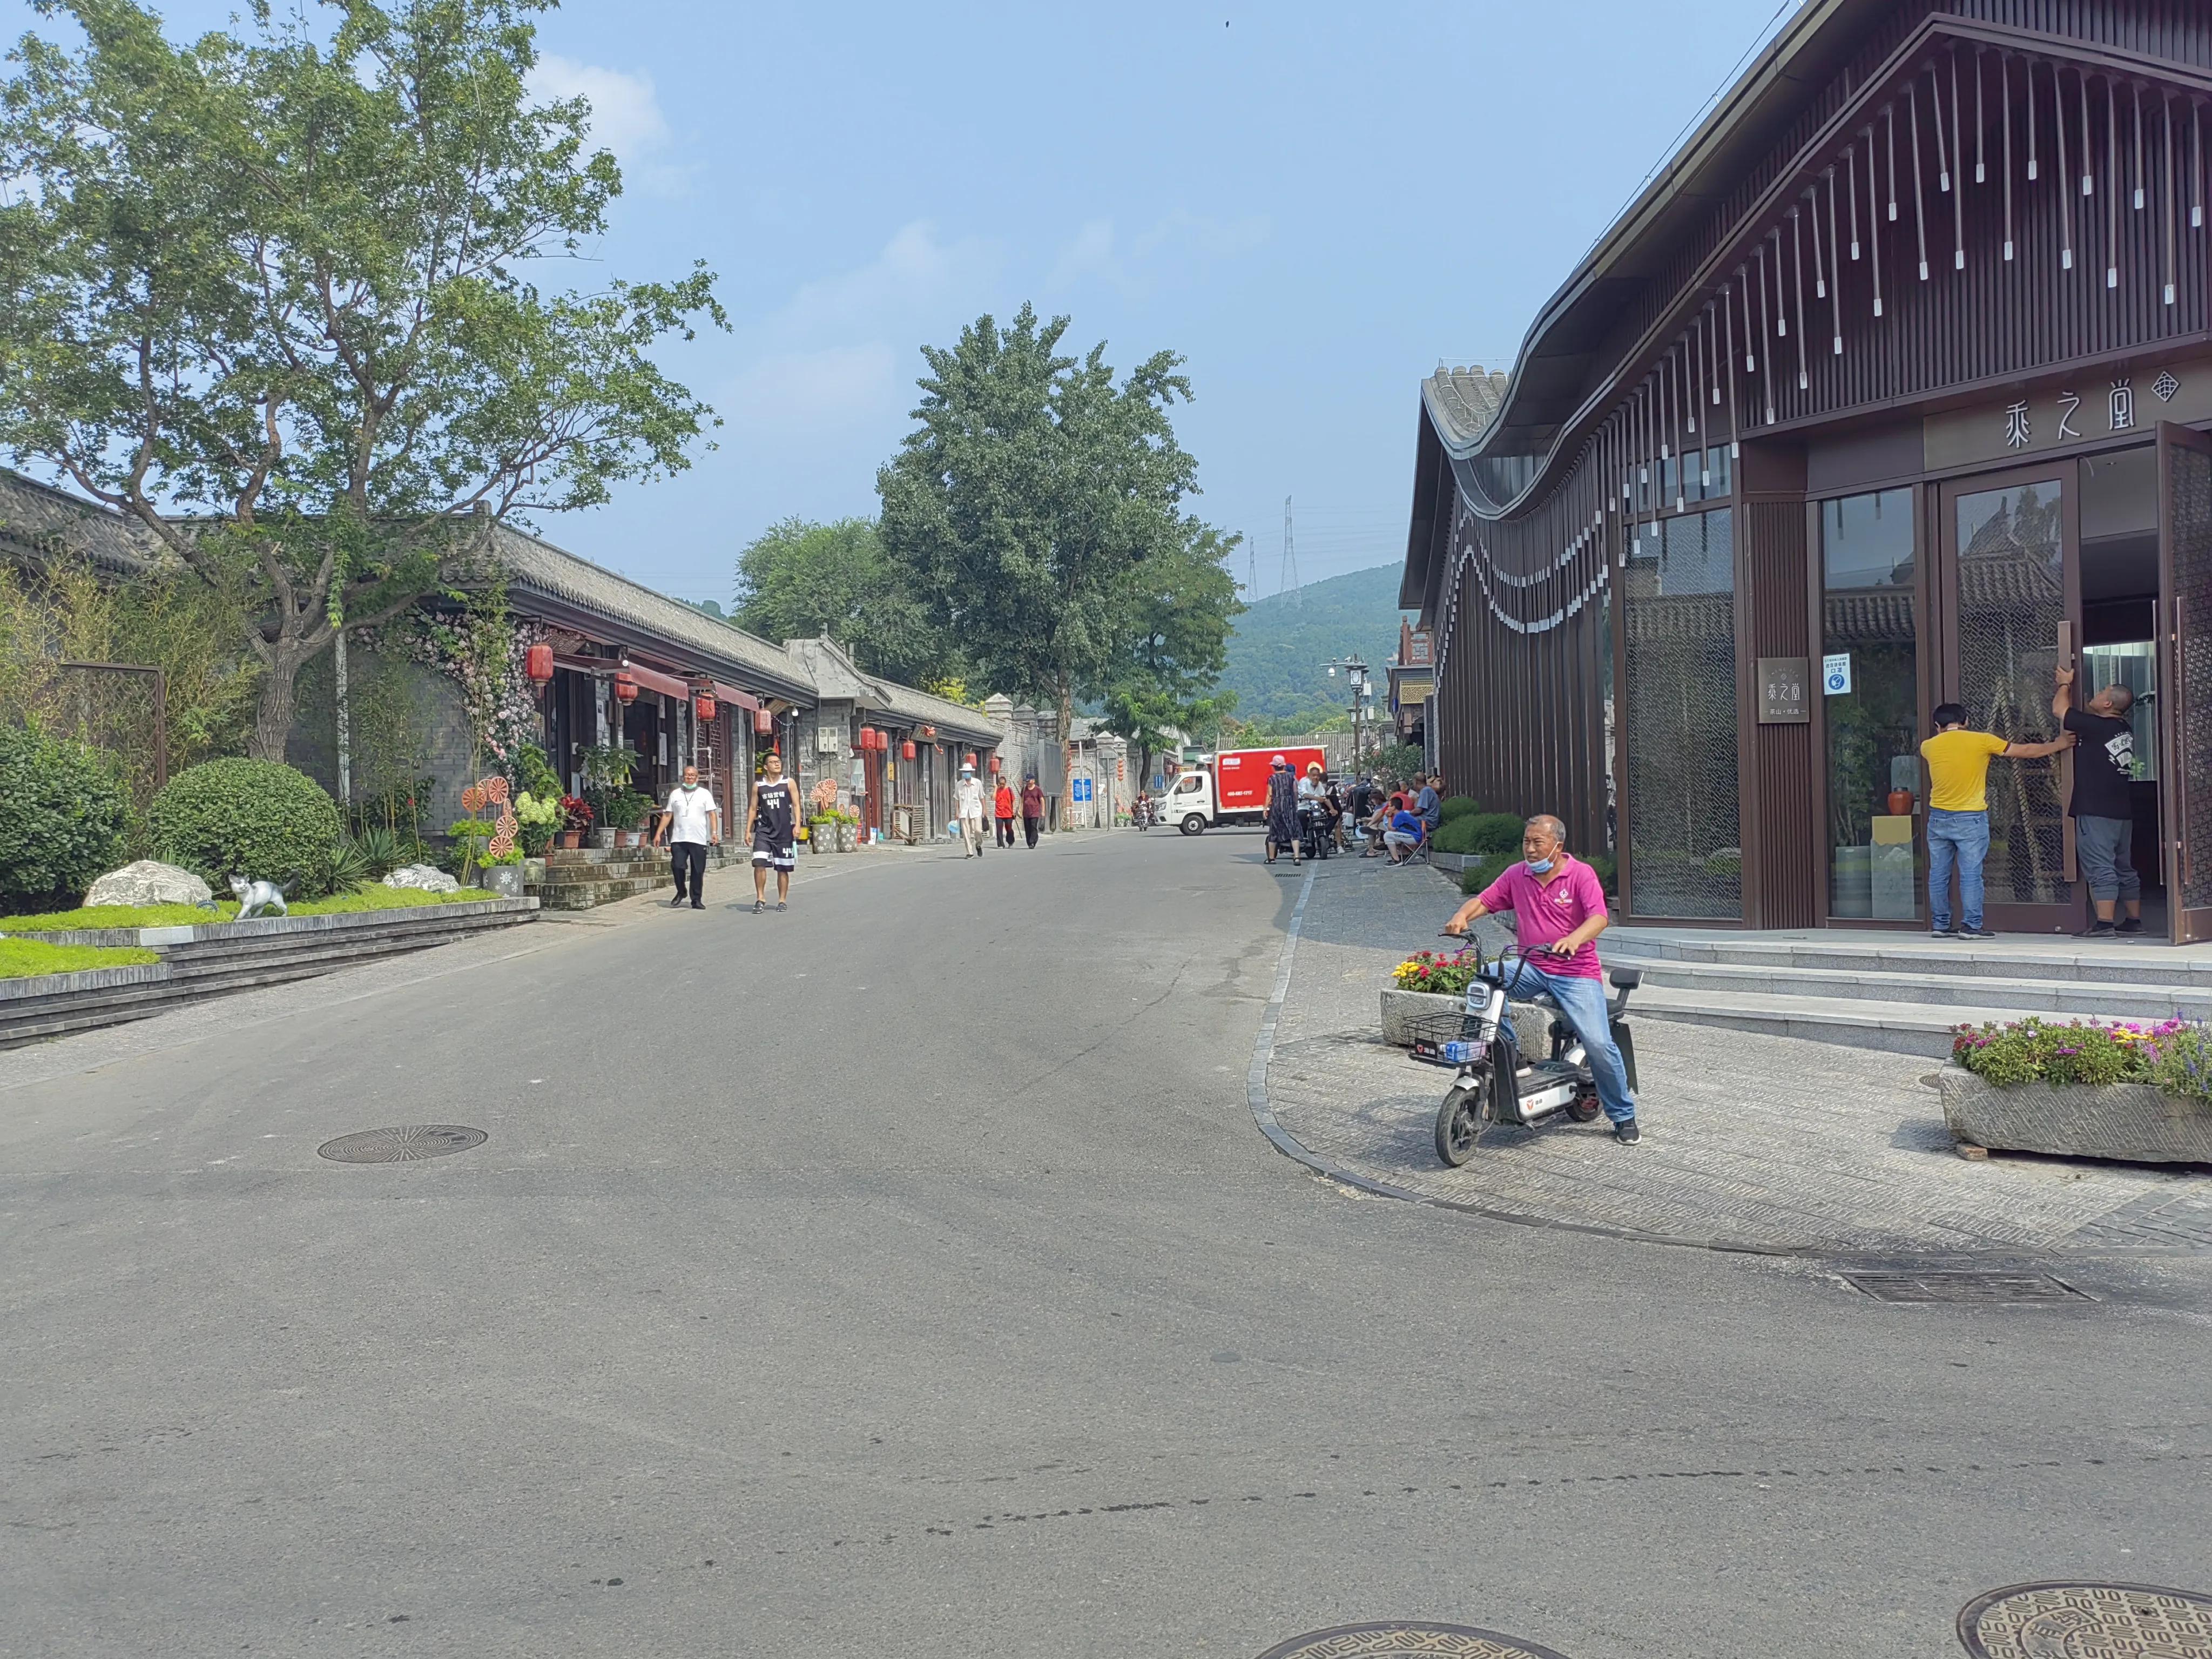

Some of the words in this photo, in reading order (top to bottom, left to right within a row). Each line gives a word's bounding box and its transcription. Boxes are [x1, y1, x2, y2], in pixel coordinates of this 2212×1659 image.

[762, 791, 785, 800] 市场营销
[767, 798, 779, 810] 44
